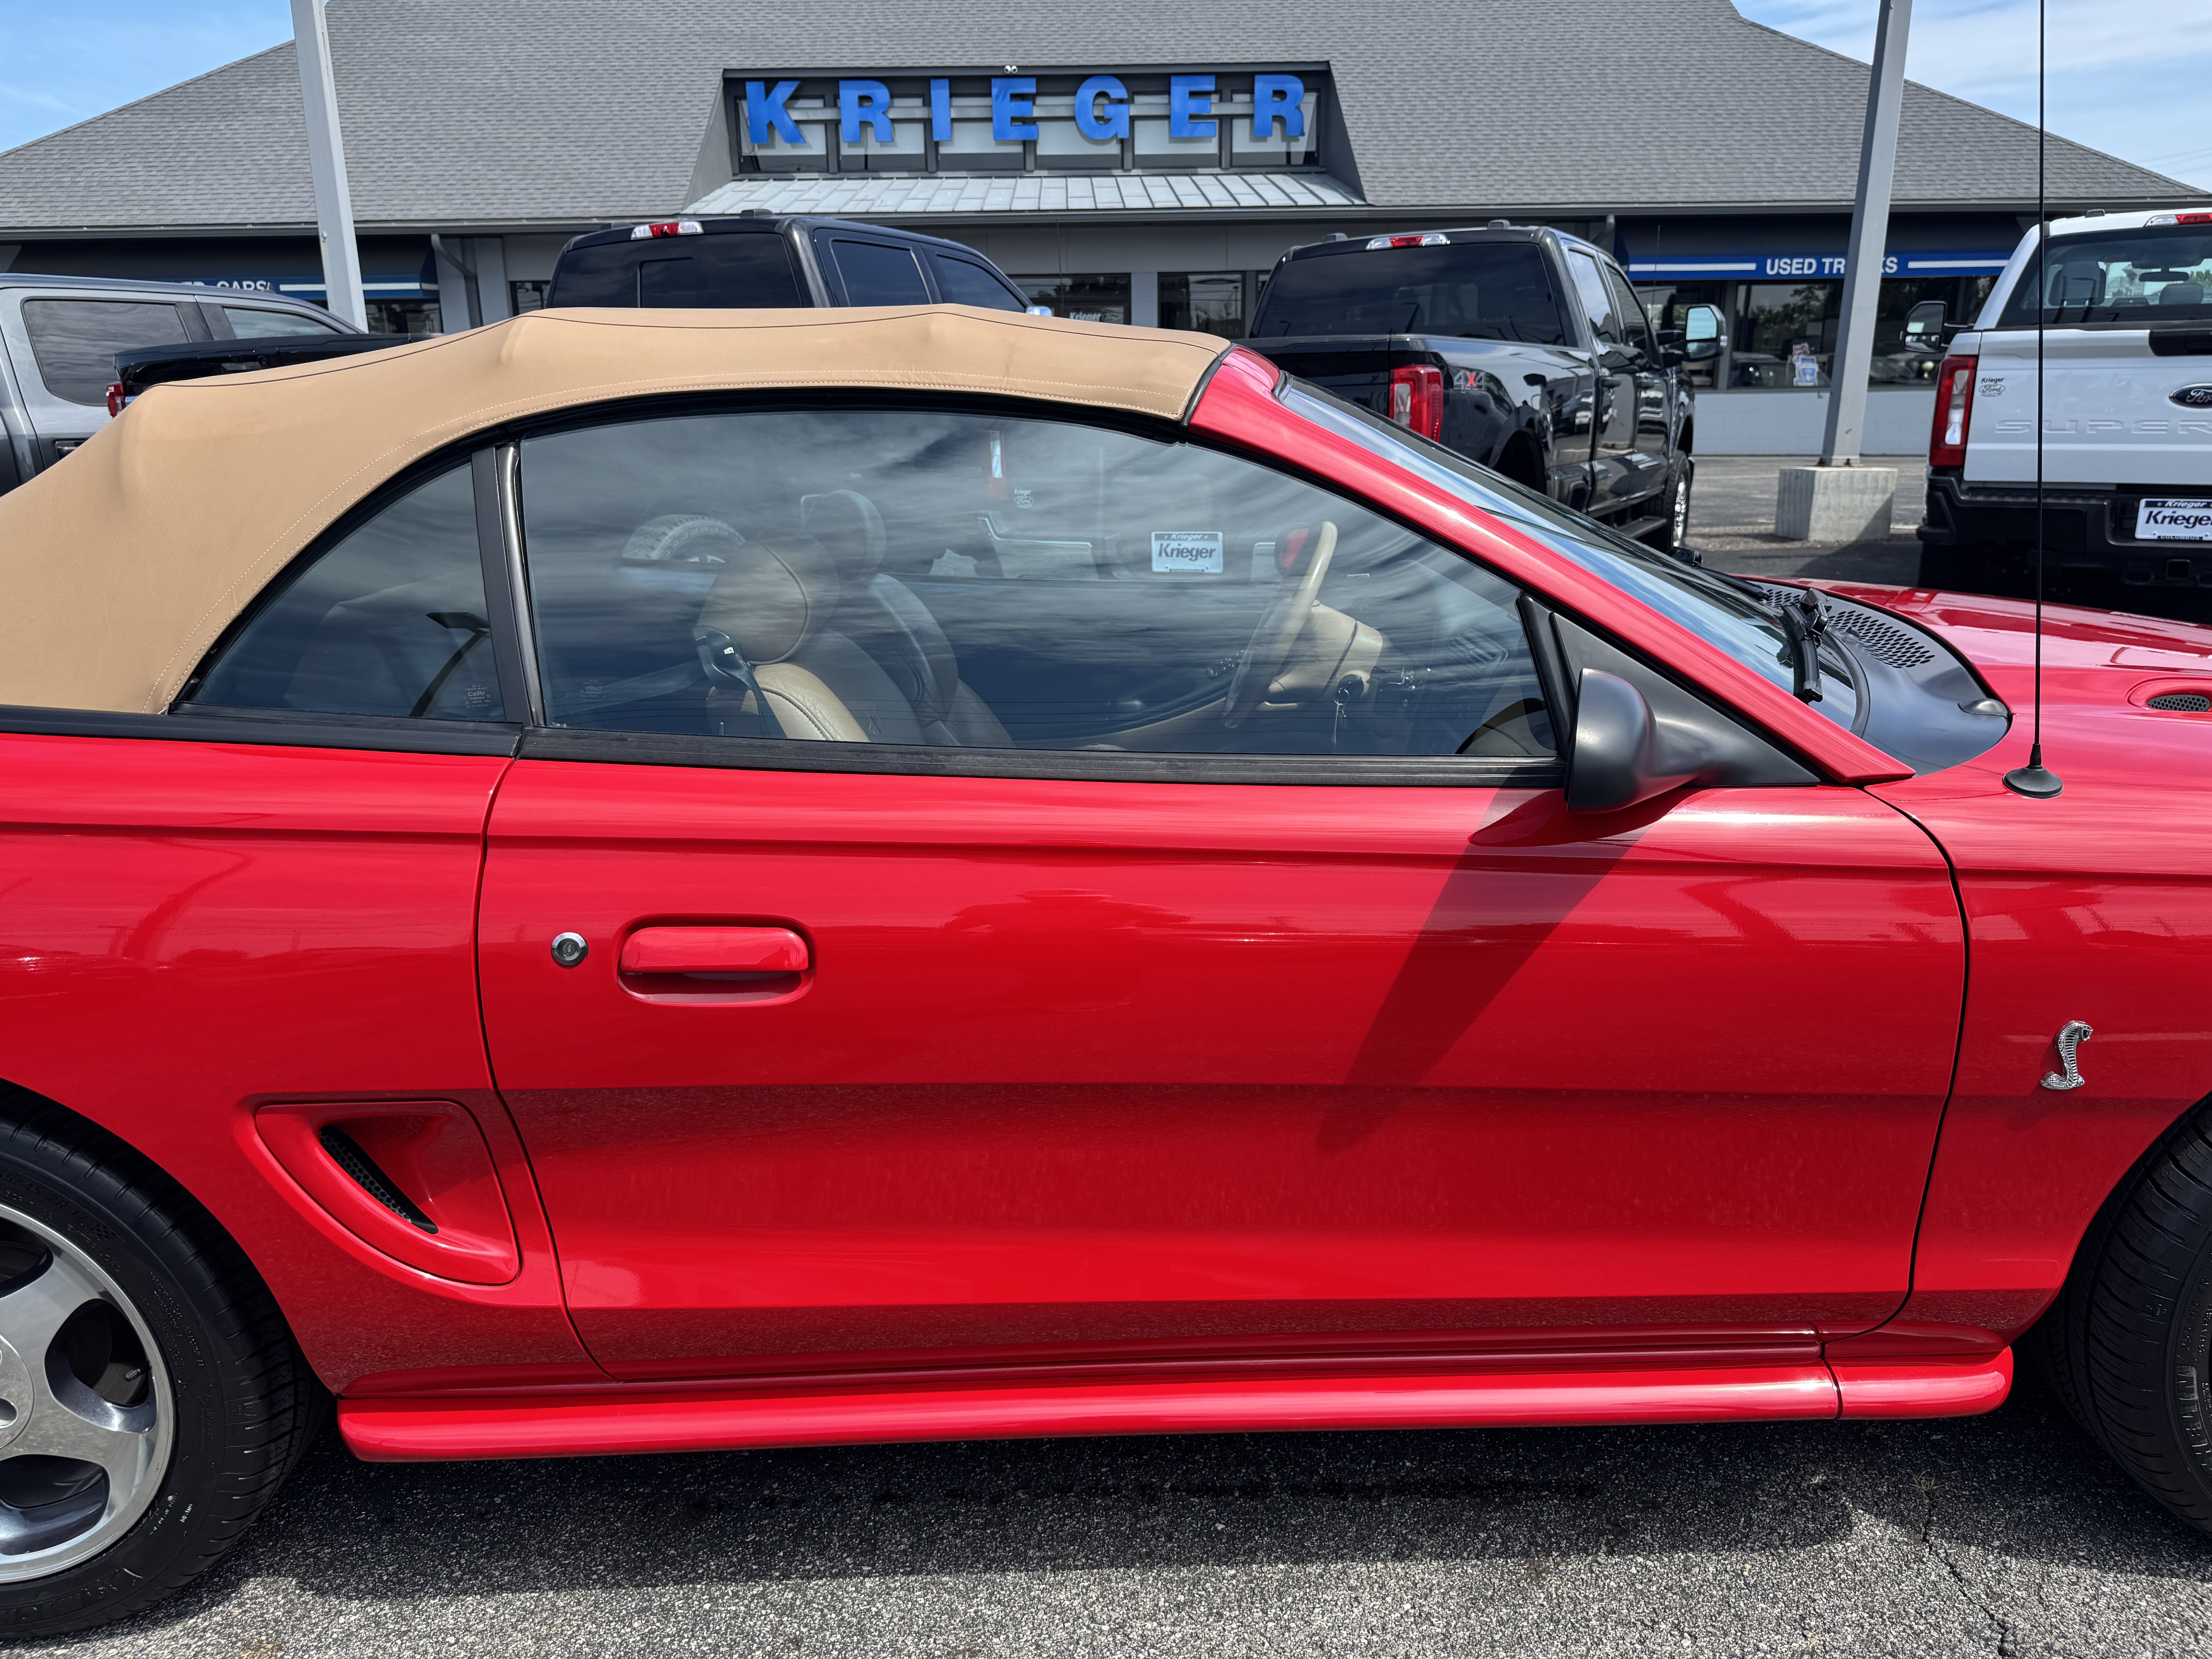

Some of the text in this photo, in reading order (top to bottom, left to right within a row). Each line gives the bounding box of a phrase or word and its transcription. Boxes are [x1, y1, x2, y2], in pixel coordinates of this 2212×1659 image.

[745, 74, 1305, 144] KRIEGER
[1766, 257, 1898, 275] USED TRS
[2186, 388, 2212, 403] For
[2145, 510, 2212, 529] Kriege
[1159, 543, 1216, 561] Krieger
